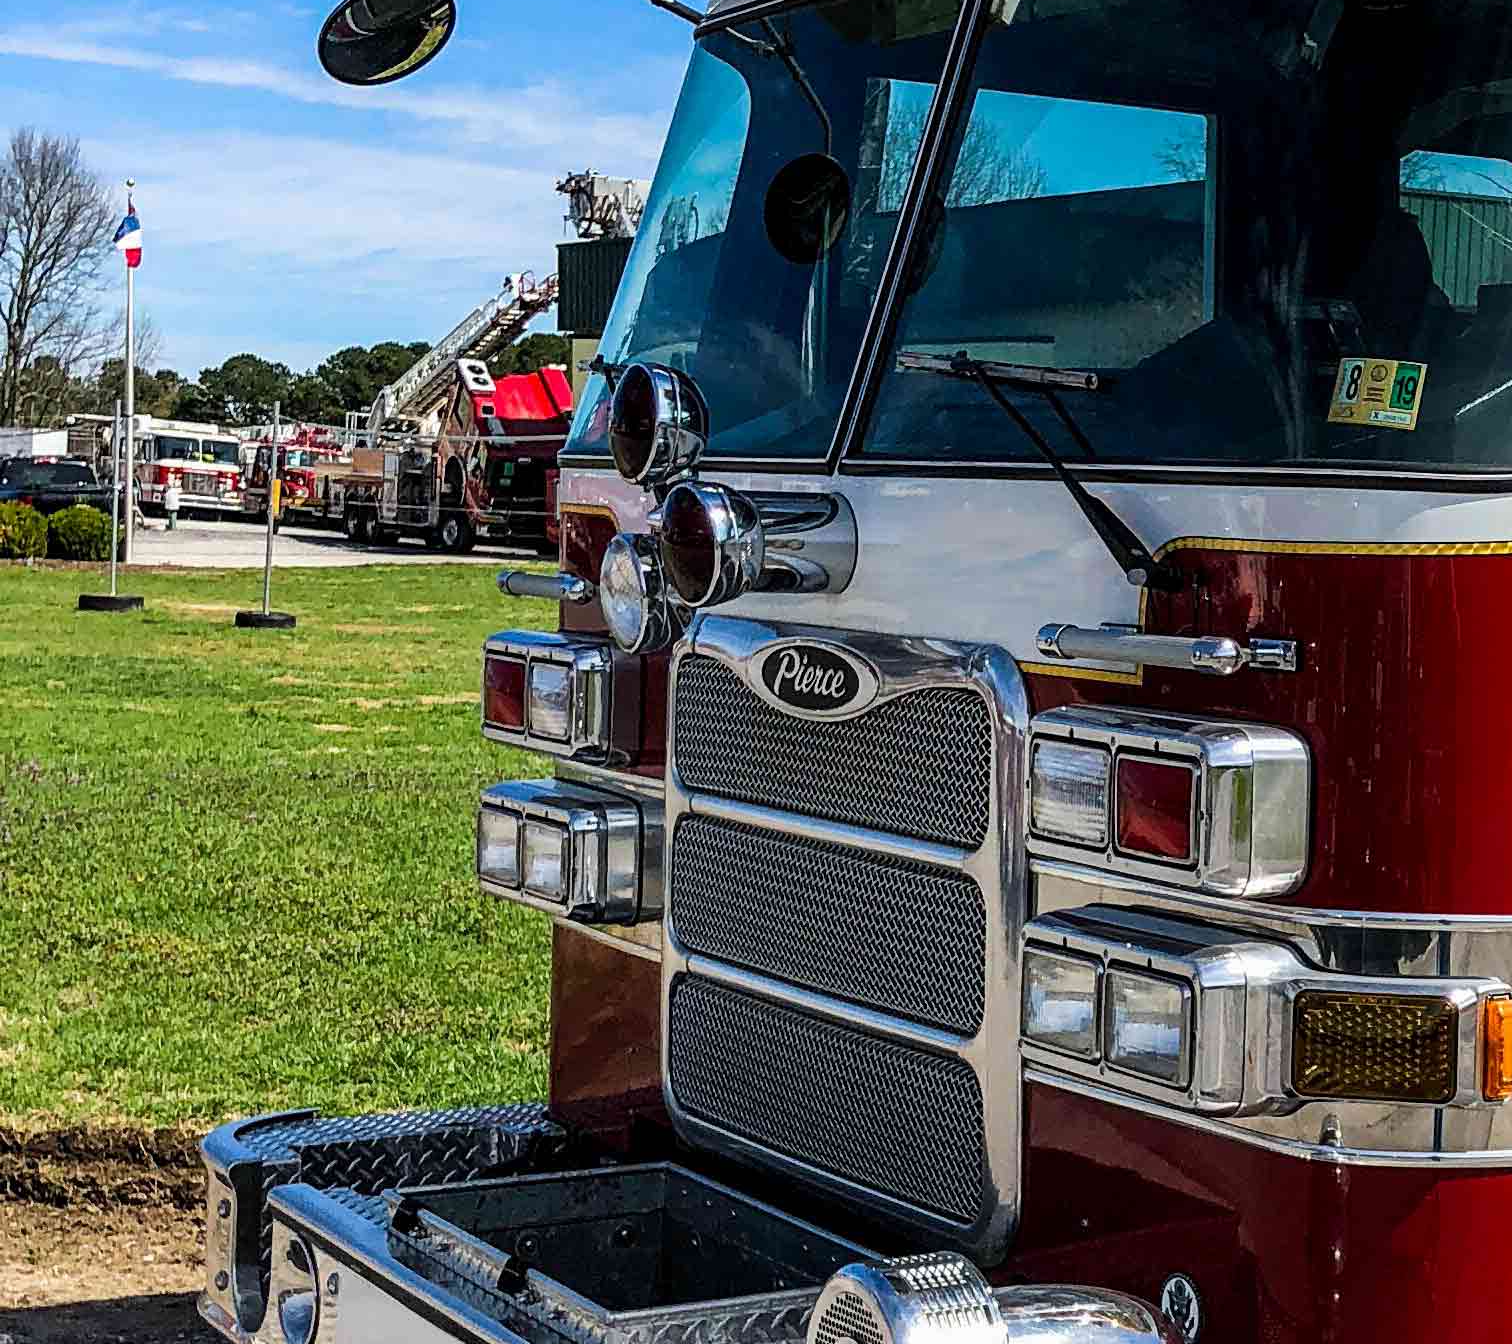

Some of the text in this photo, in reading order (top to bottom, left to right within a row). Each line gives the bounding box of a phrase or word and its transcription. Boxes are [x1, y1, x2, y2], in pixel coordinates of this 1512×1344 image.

[1345, 364, 1362, 400] 8
[1395, 375, 1418, 405] 19
[773, 647, 846, 699] Pierce
